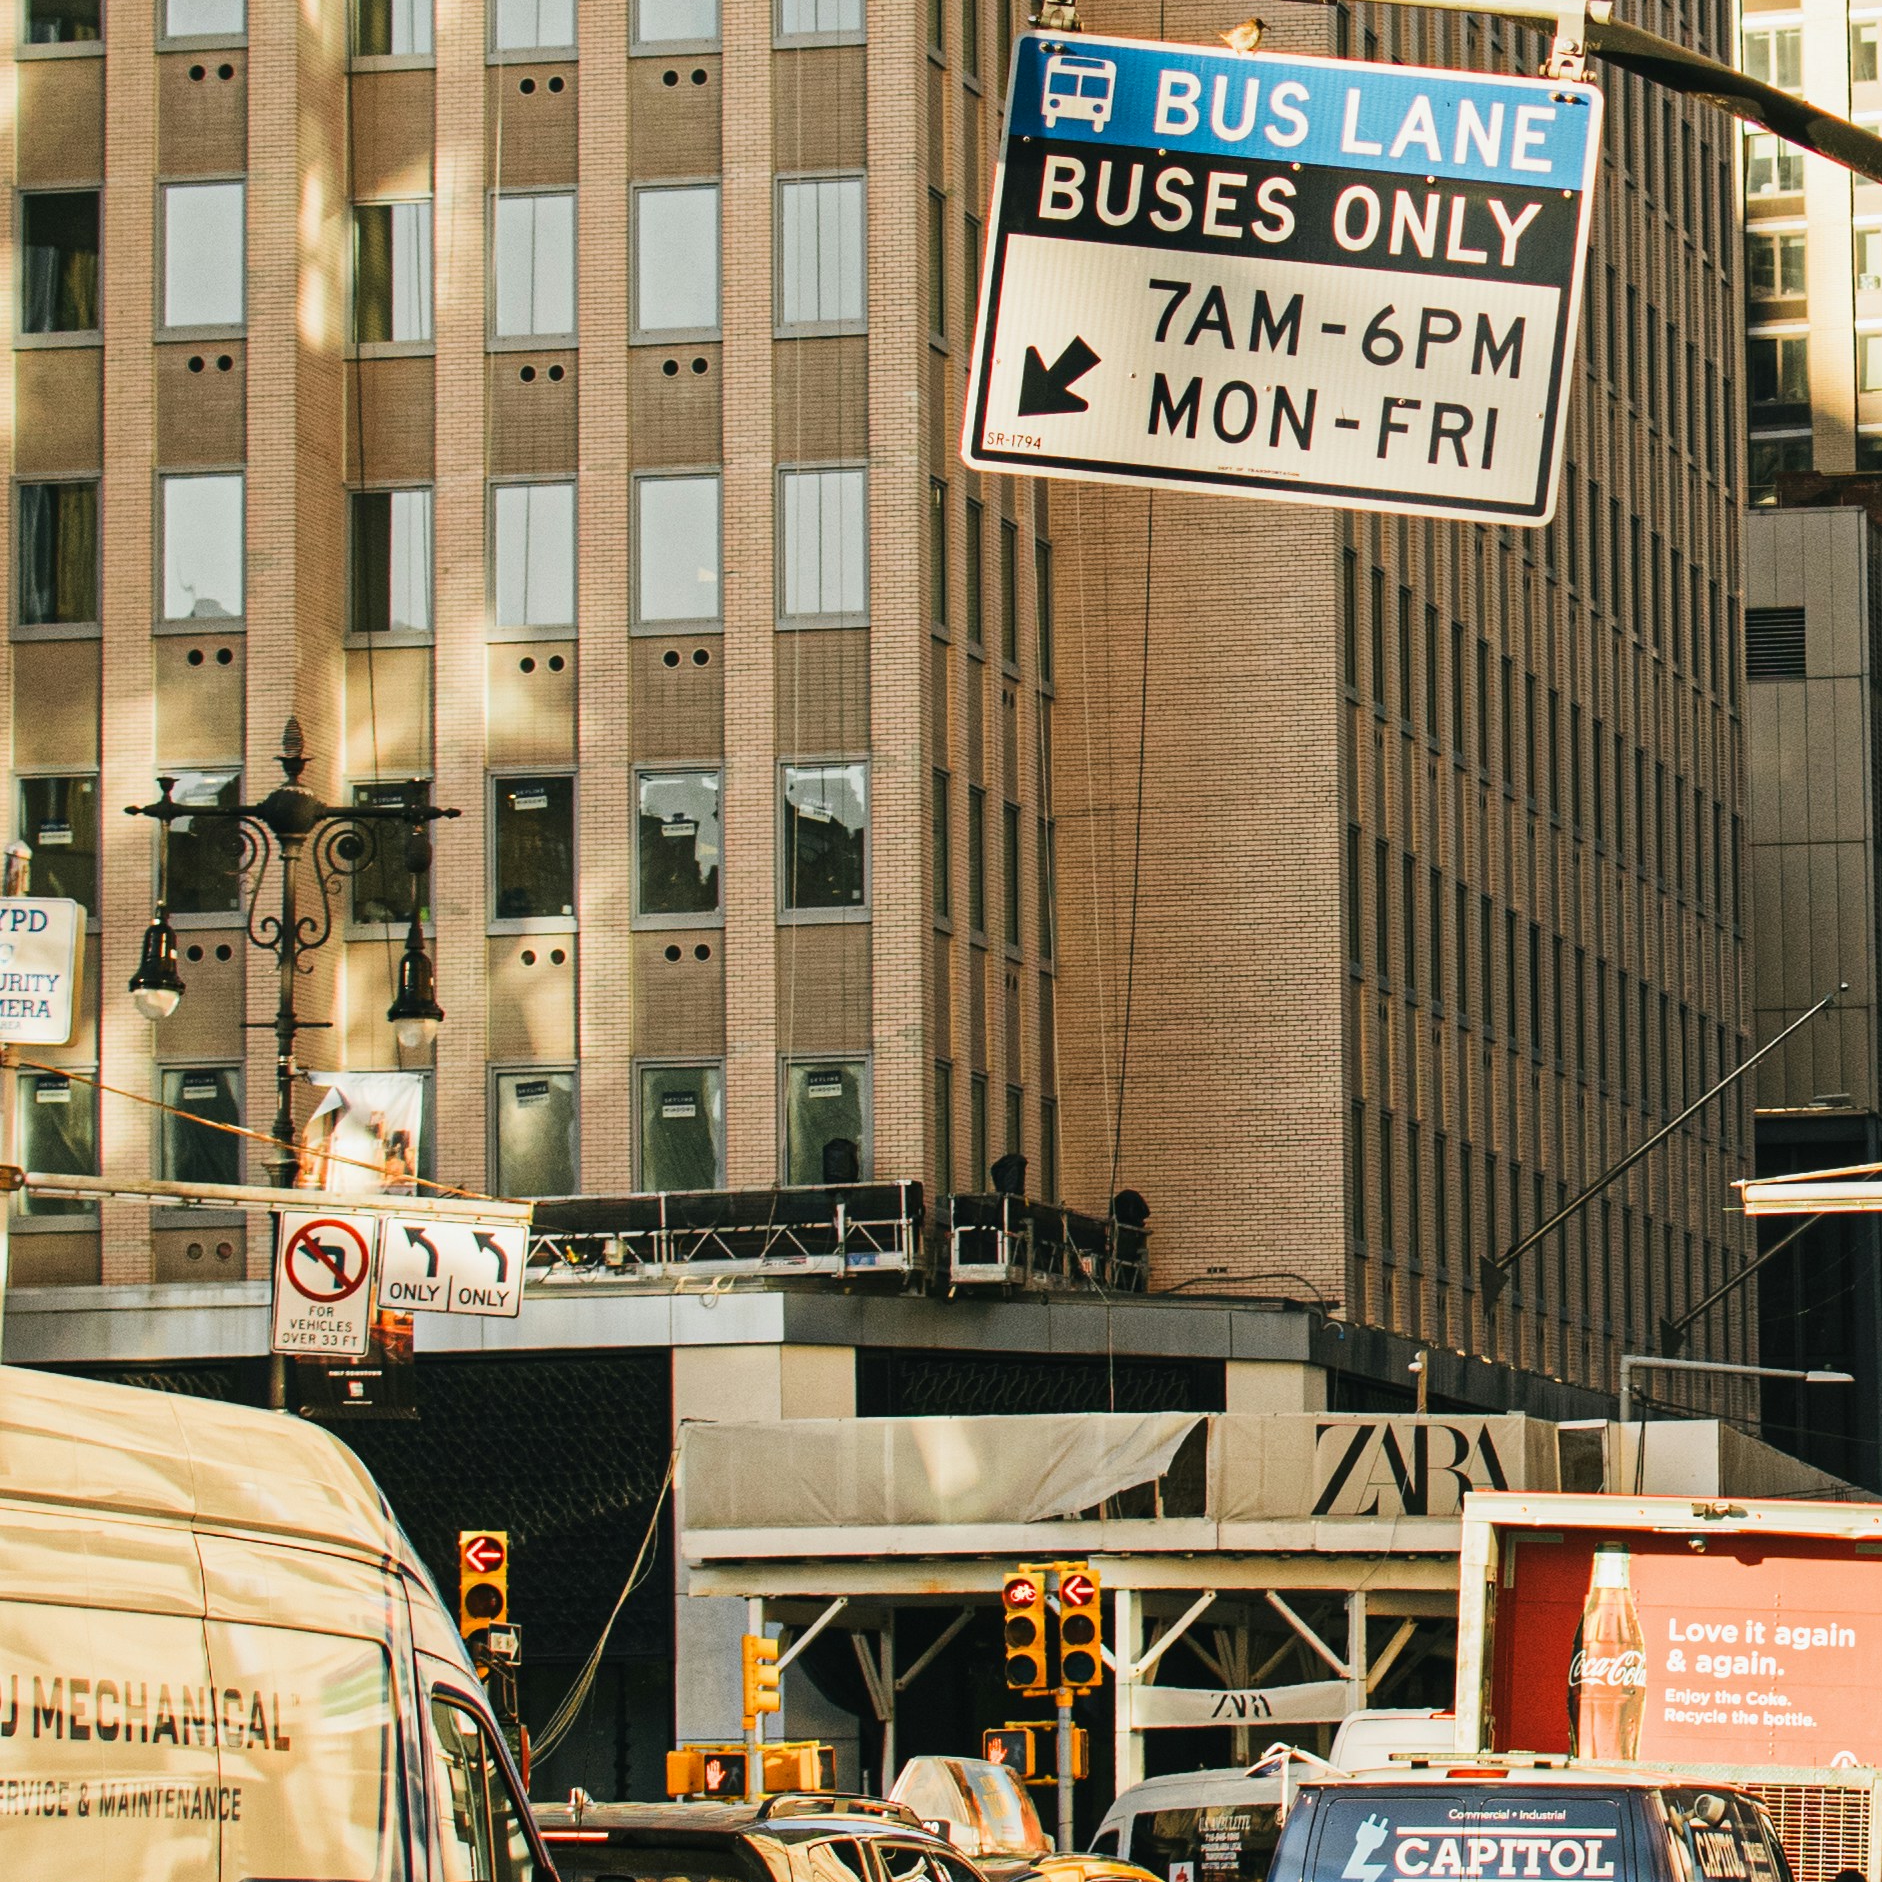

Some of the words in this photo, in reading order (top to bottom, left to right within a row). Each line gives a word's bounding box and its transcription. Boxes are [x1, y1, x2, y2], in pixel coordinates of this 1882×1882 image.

[1154, 69, 1310, 148] BUS
[1341, 87, 1557, 173] LANE
[1038, 155, 1298, 242] BUSES
[1333, 185, 1543, 267] ONLY
[987, 431, 1042, 450] SR-1794
[390, 1282, 441, 1303] ONLY
[458, 1288, 509, 1308] ONLY
[290, 1319, 353, 1332] VEHICLES
[308, 1305, 335, 1318] FOR
[282, 1333, 317, 1345] OVER
[322, 1334, 338, 1346] 33
[343, 1336, 358, 1347] FT
[1311, 1422, 1509, 1516] ZARA
[1667, 1618, 1738, 1644] Love
[1744, 1619, 1766, 1645] it
[1774, 1623, 1856, 1651] again
[1568, 1649, 1648, 1688] Coca-Cola
[1666, 1650, 1687, 1674] &
[1695, 1653, 1785, 1680] again.
[33, 1676, 291, 1752] MECHANICAL
[1664, 1688, 1710, 1711] Enjoy
[1714, 1689, 1741, 1706] the
[1745, 1690, 1792, 1707] Coke.
[1664, 1708, 1726, 1727] Recycle
[1731, 1709, 1759, 1726] the
[1763, 1710, 1818, 1728] bottle.
[78, 1782, 90, 1817] &
[100, 1781, 242, 1822] MAINTENANCE
[1448, 1807, 1511, 1821] Commercial
[1519, 1807, 1566, 1821] Industrial
[1394, 1836, 1615, 1877] CAPITOL
[1695, 1831, 1747, 1878] CAPITOL
